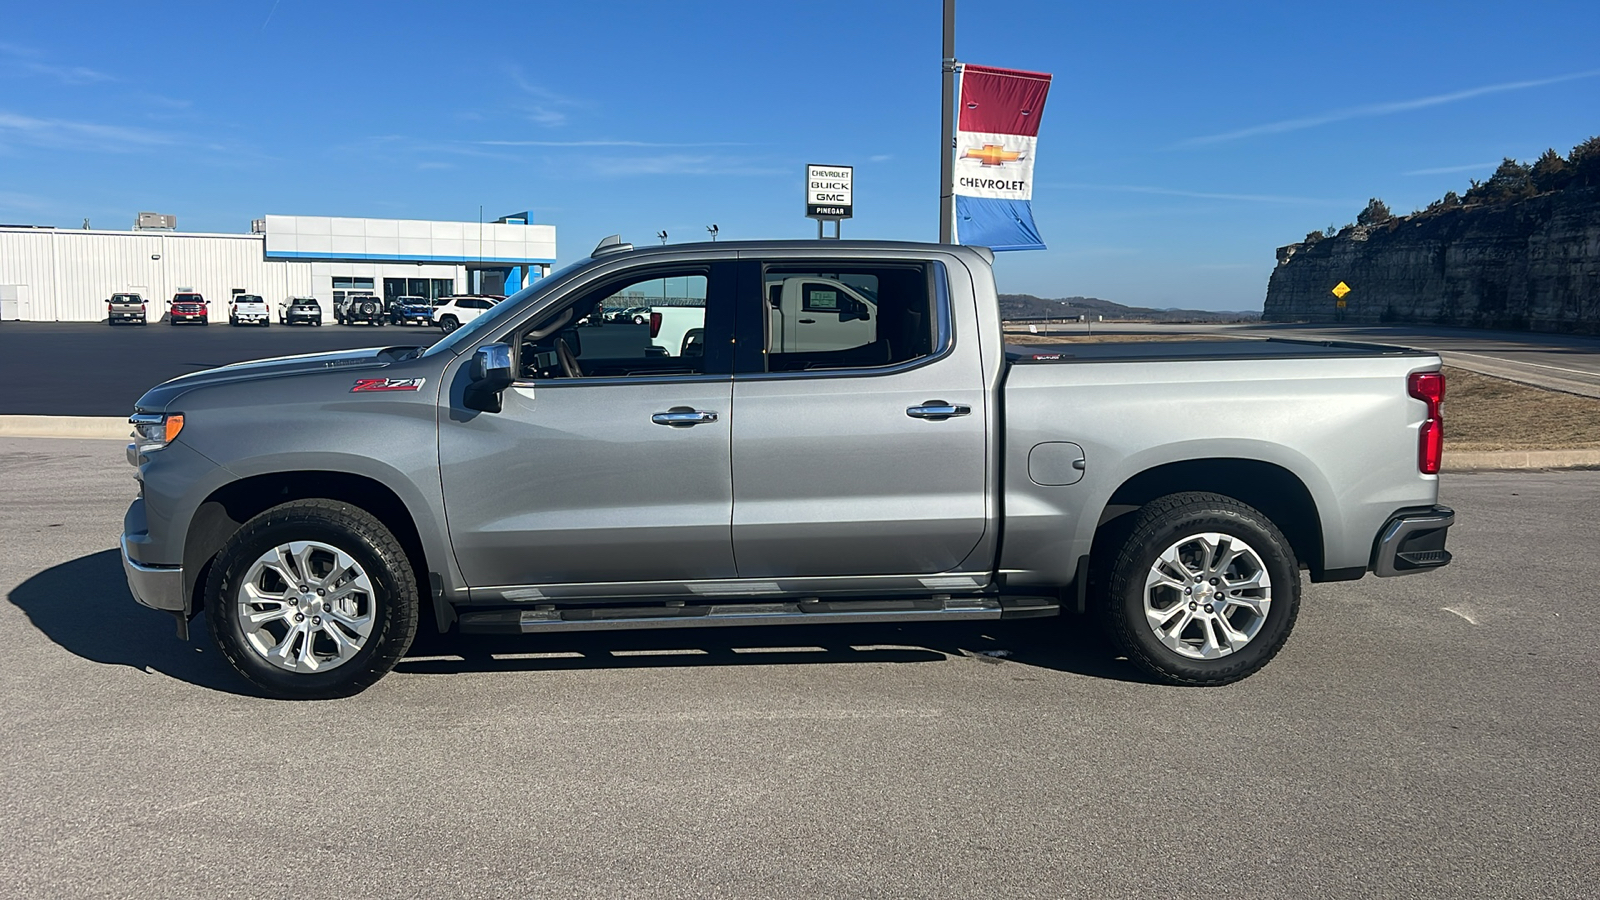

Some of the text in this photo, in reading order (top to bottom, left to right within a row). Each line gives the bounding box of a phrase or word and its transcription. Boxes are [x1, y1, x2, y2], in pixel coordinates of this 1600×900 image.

[812, 170, 849, 178] CHEVROLET
[811, 181, 849, 190] BUICK
[959, 177, 1024, 191] CHEVROLET
[816, 193, 844, 201] GMC
[351, 377, 426, 392] Z71
